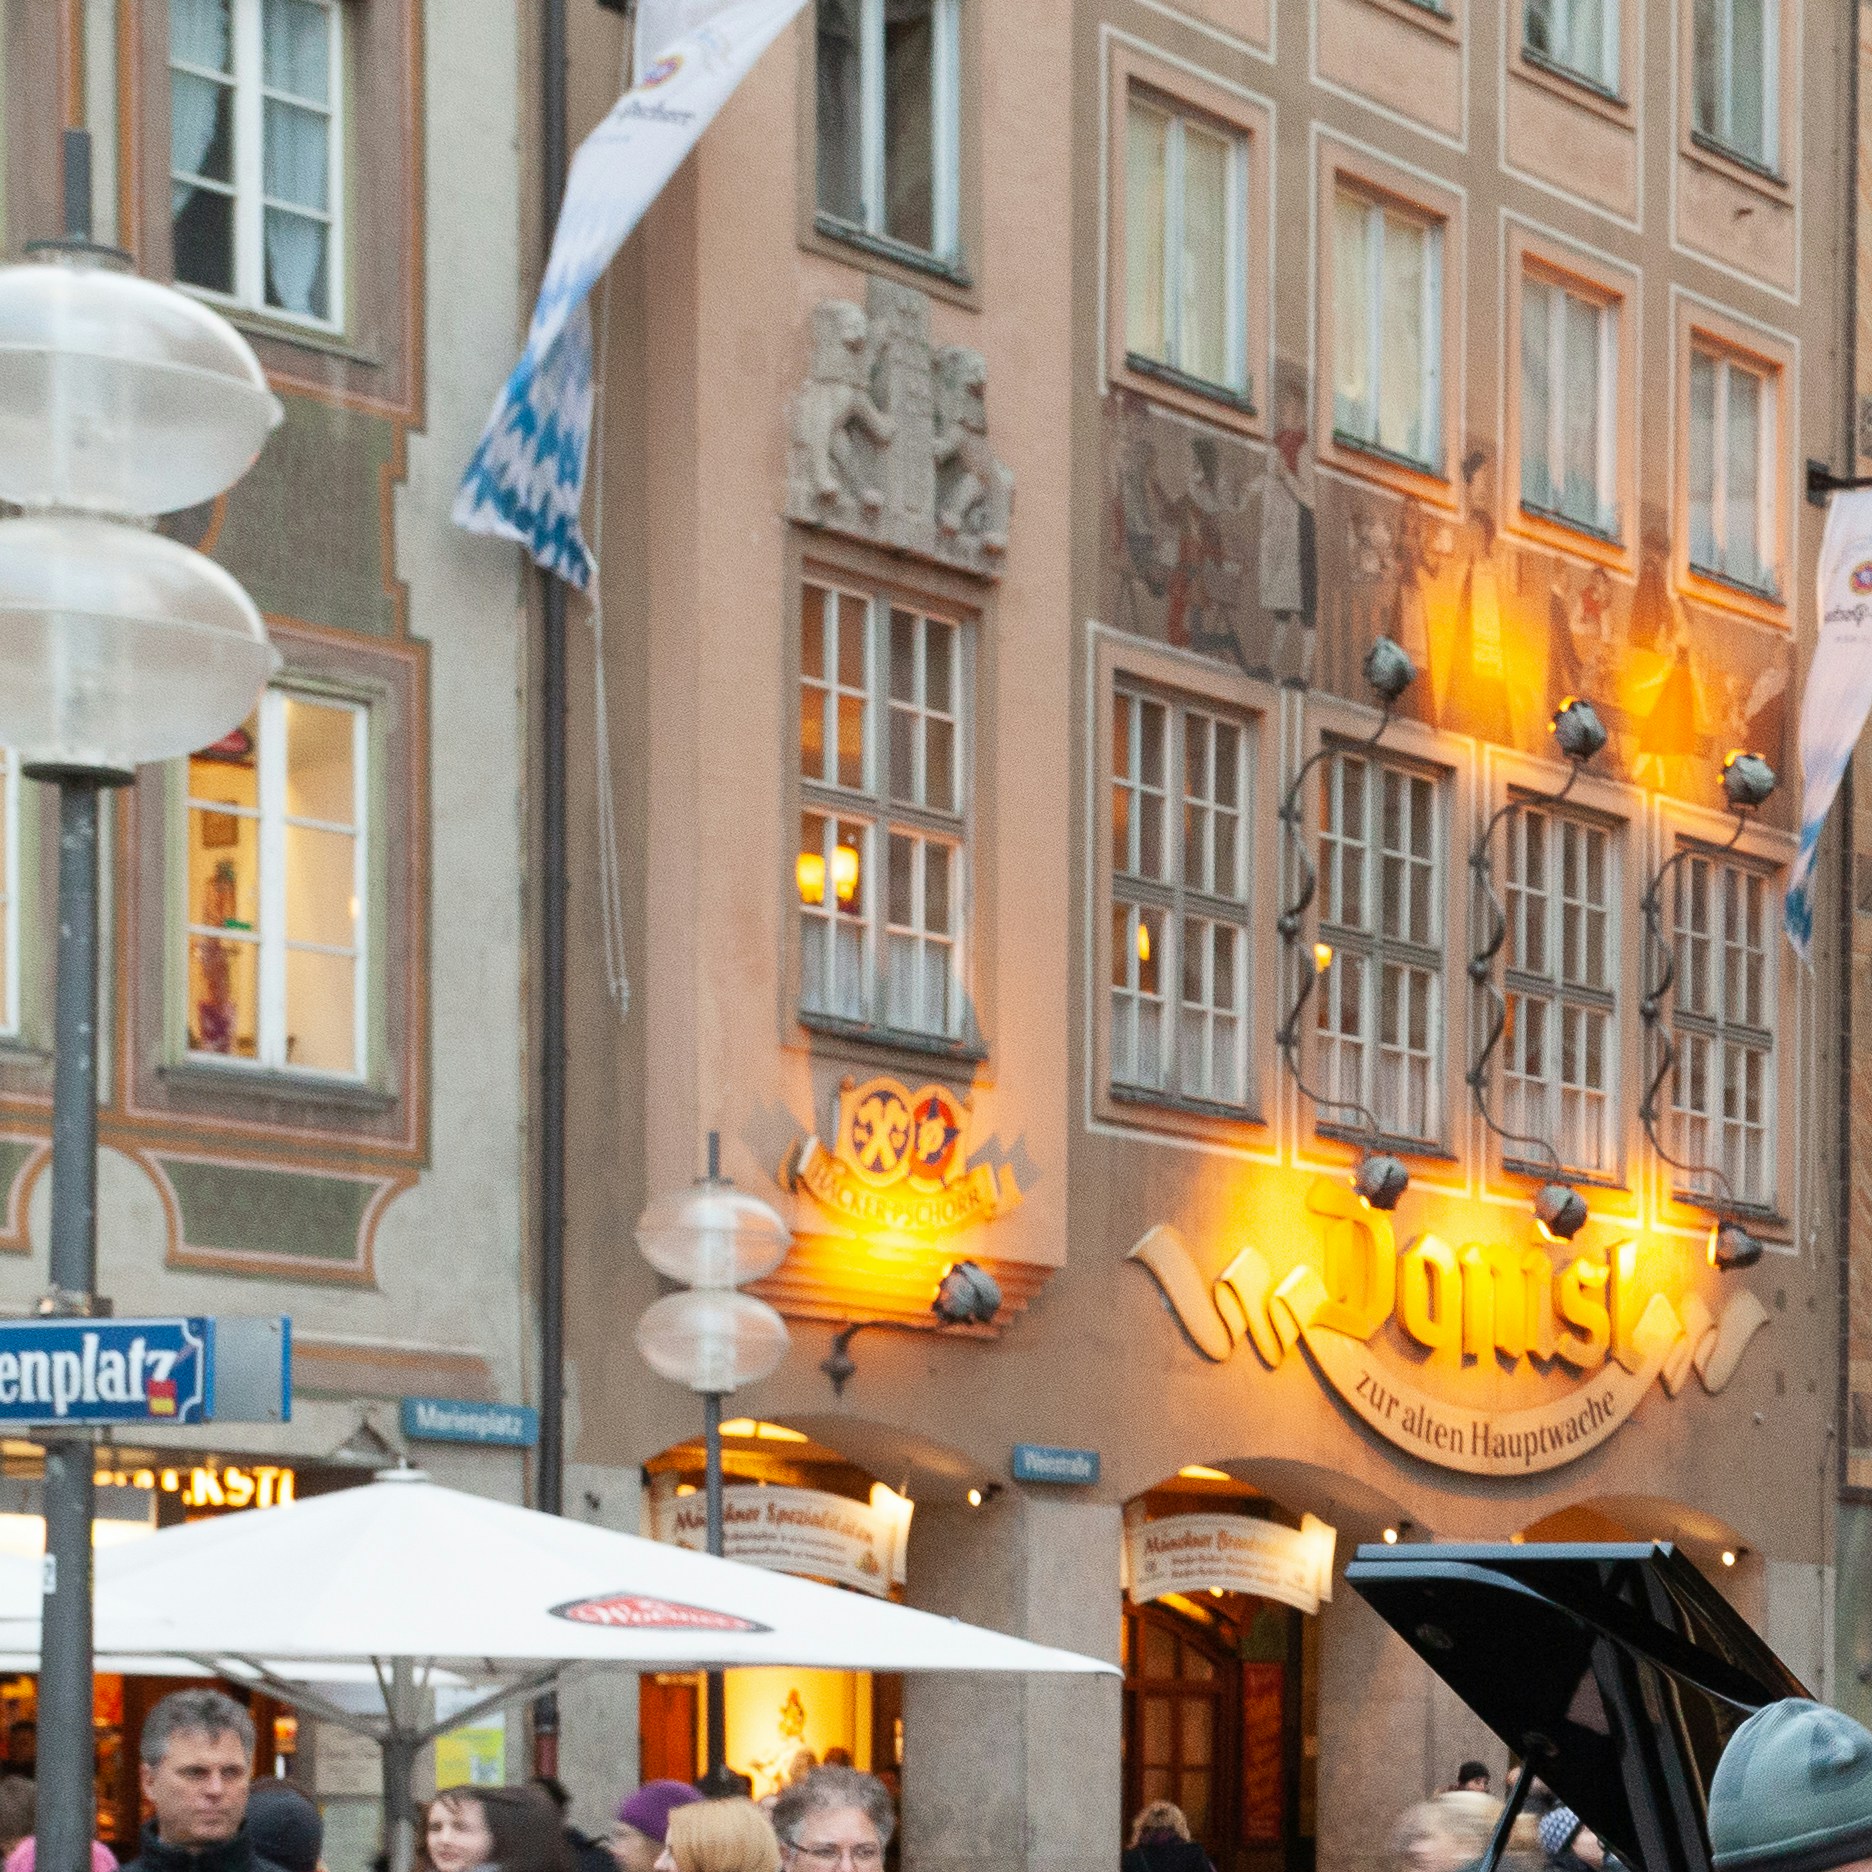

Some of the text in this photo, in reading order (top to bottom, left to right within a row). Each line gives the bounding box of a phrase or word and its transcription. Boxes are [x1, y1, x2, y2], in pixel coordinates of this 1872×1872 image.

[1355, 1368, 1617, 1468] zur alten Hauptwache
